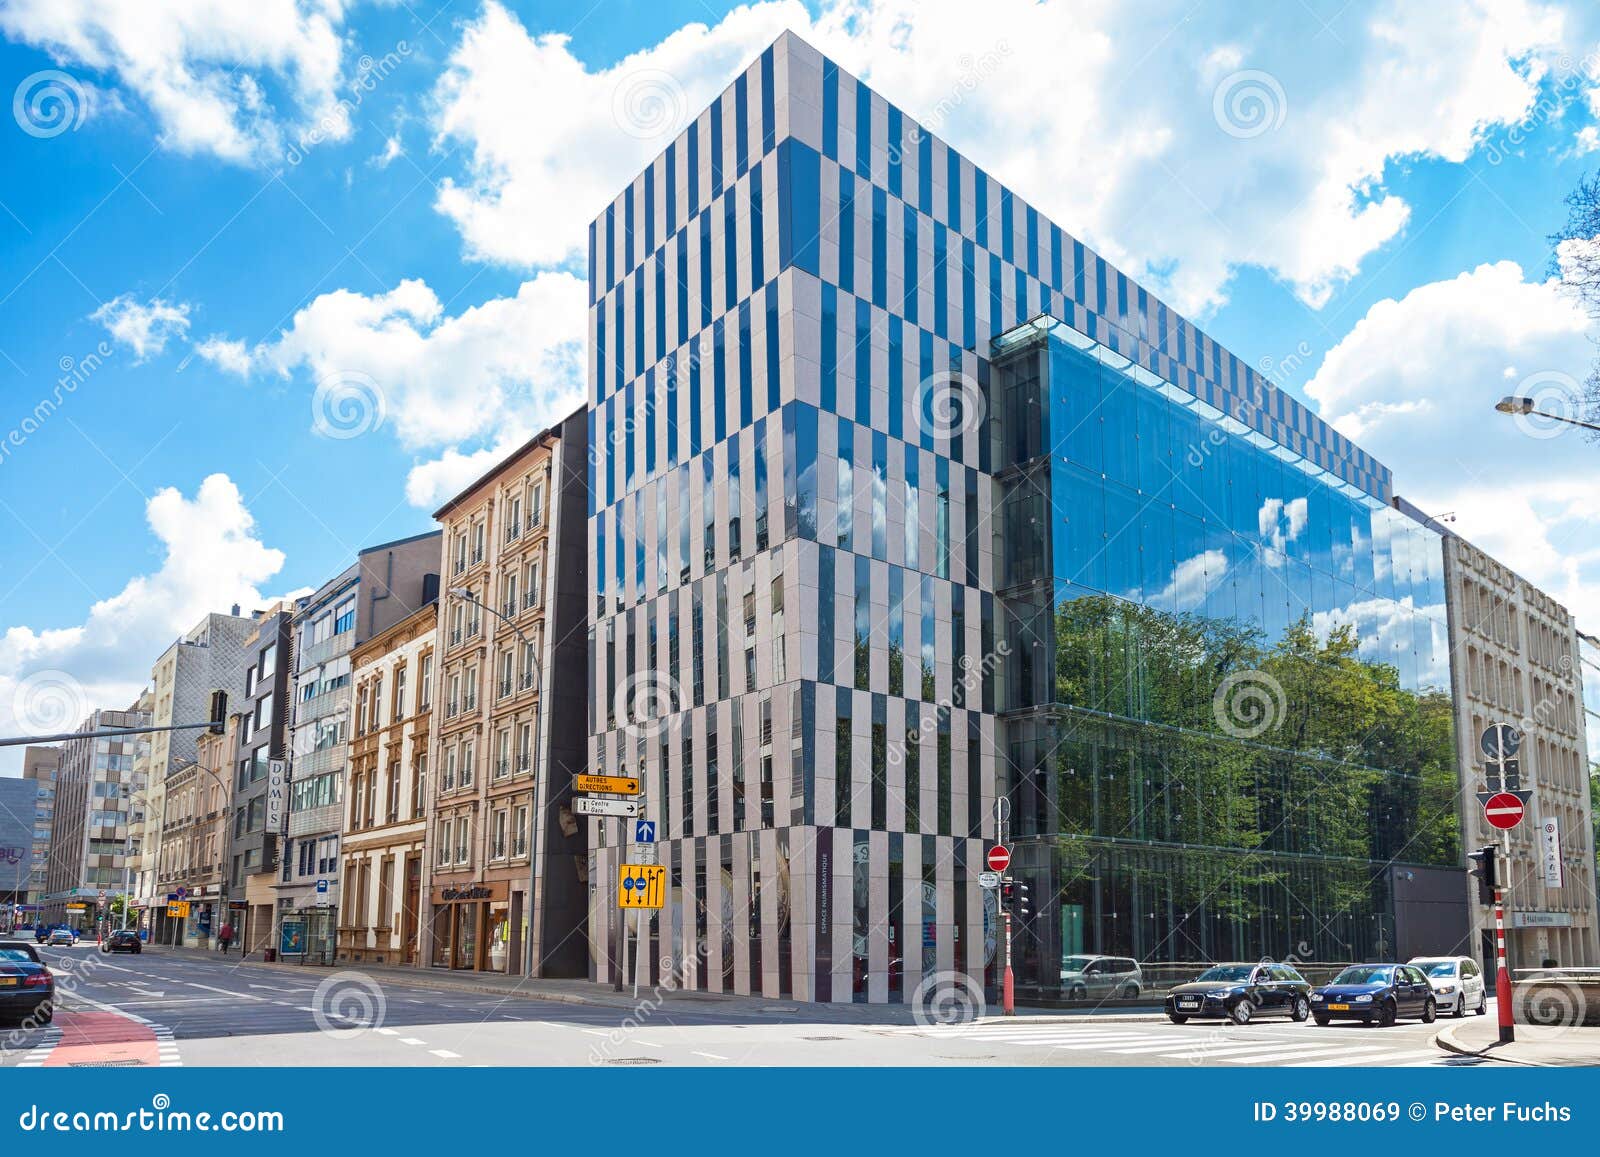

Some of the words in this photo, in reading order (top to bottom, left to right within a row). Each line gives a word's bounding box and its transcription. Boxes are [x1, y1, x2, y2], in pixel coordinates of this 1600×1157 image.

[269, 763, 282, 824] DOMUS
[579, 783, 613, 791] DIRECTIONS
[585, 776, 608, 784] AUTRES
[821, 853, 829, 907] NUMISMATIQUE
